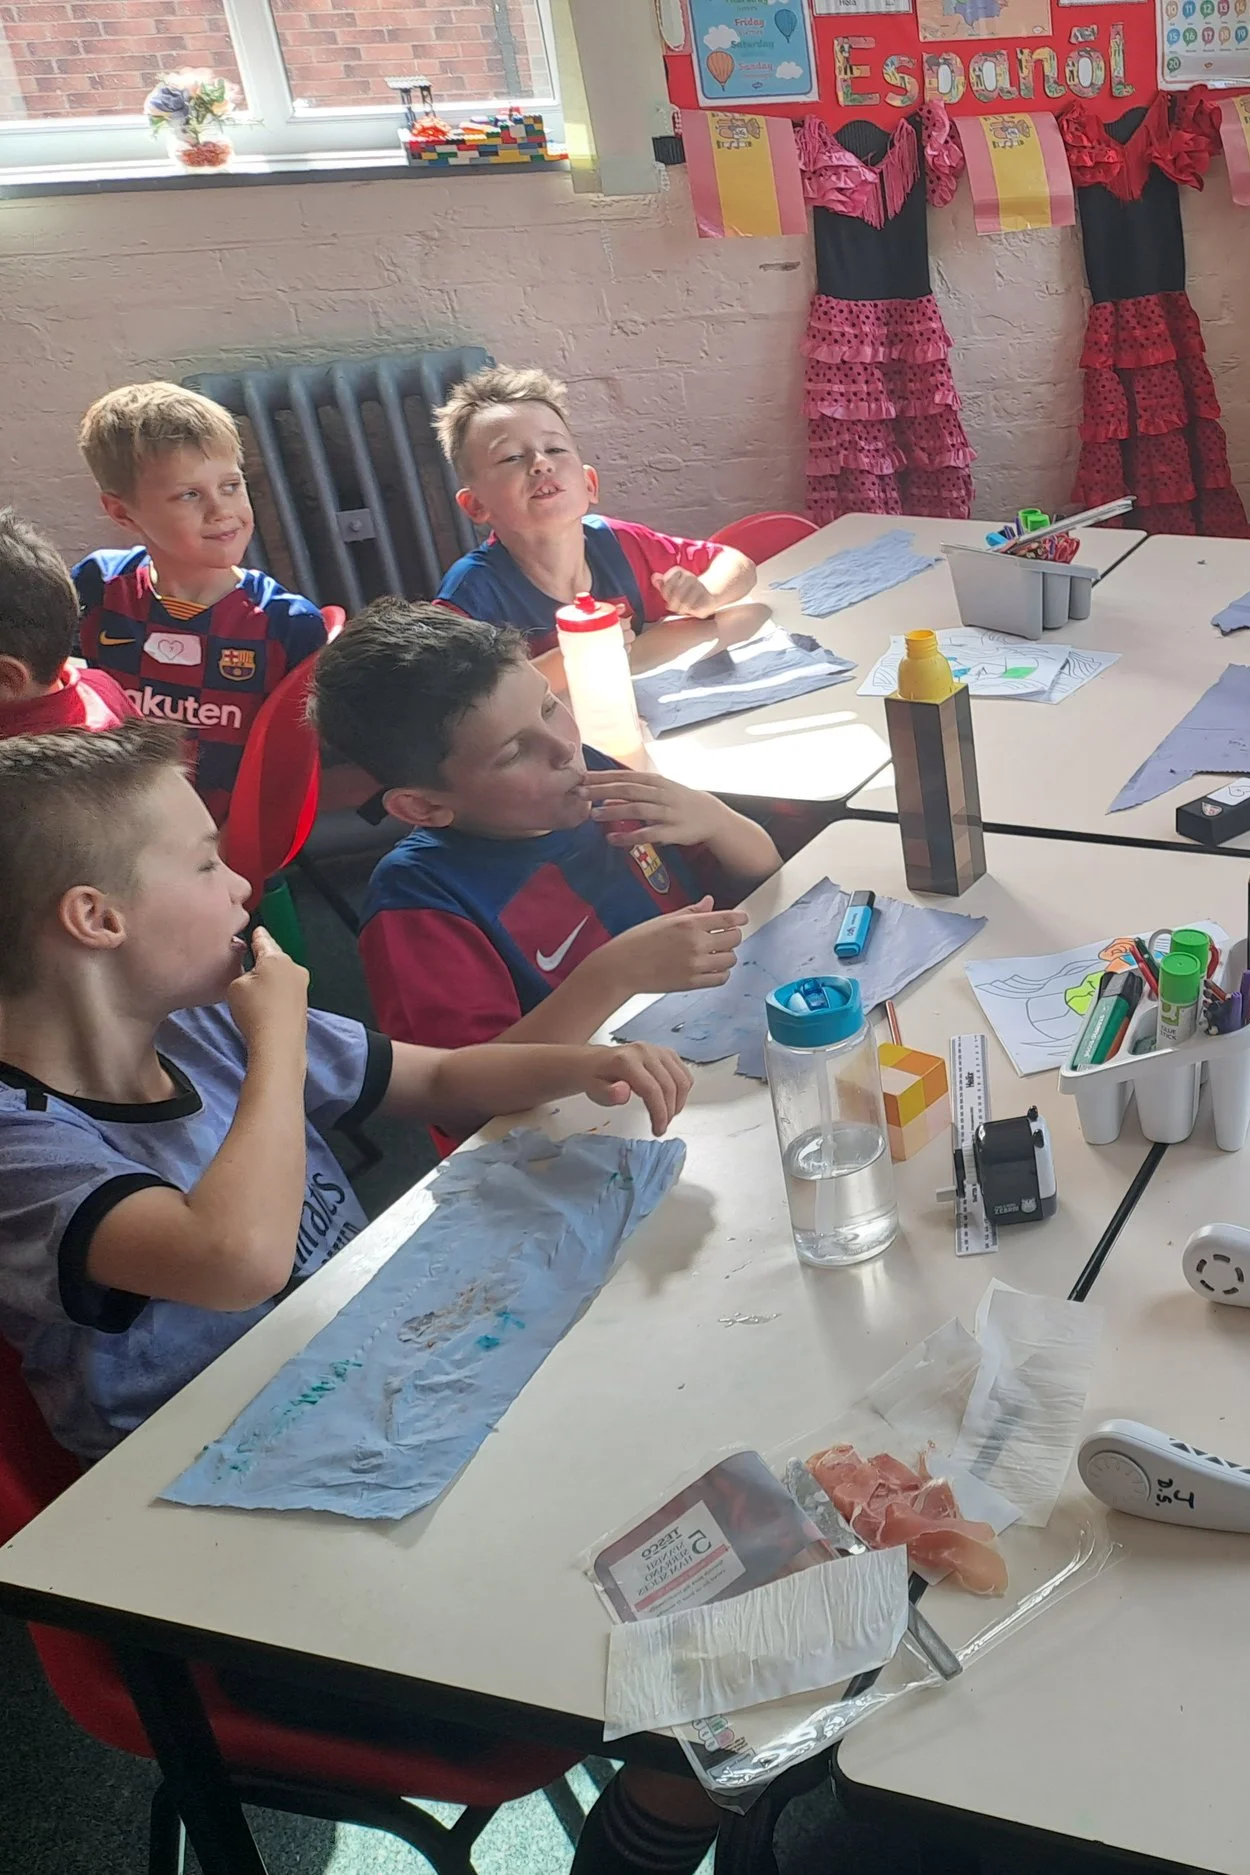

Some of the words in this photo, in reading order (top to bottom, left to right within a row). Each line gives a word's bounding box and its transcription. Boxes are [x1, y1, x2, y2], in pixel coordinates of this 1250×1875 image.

[734, 18, 764, 28] Friday
[123, 686, 242, 728] akuten
[965, 1071, 974, 1088] Helix
